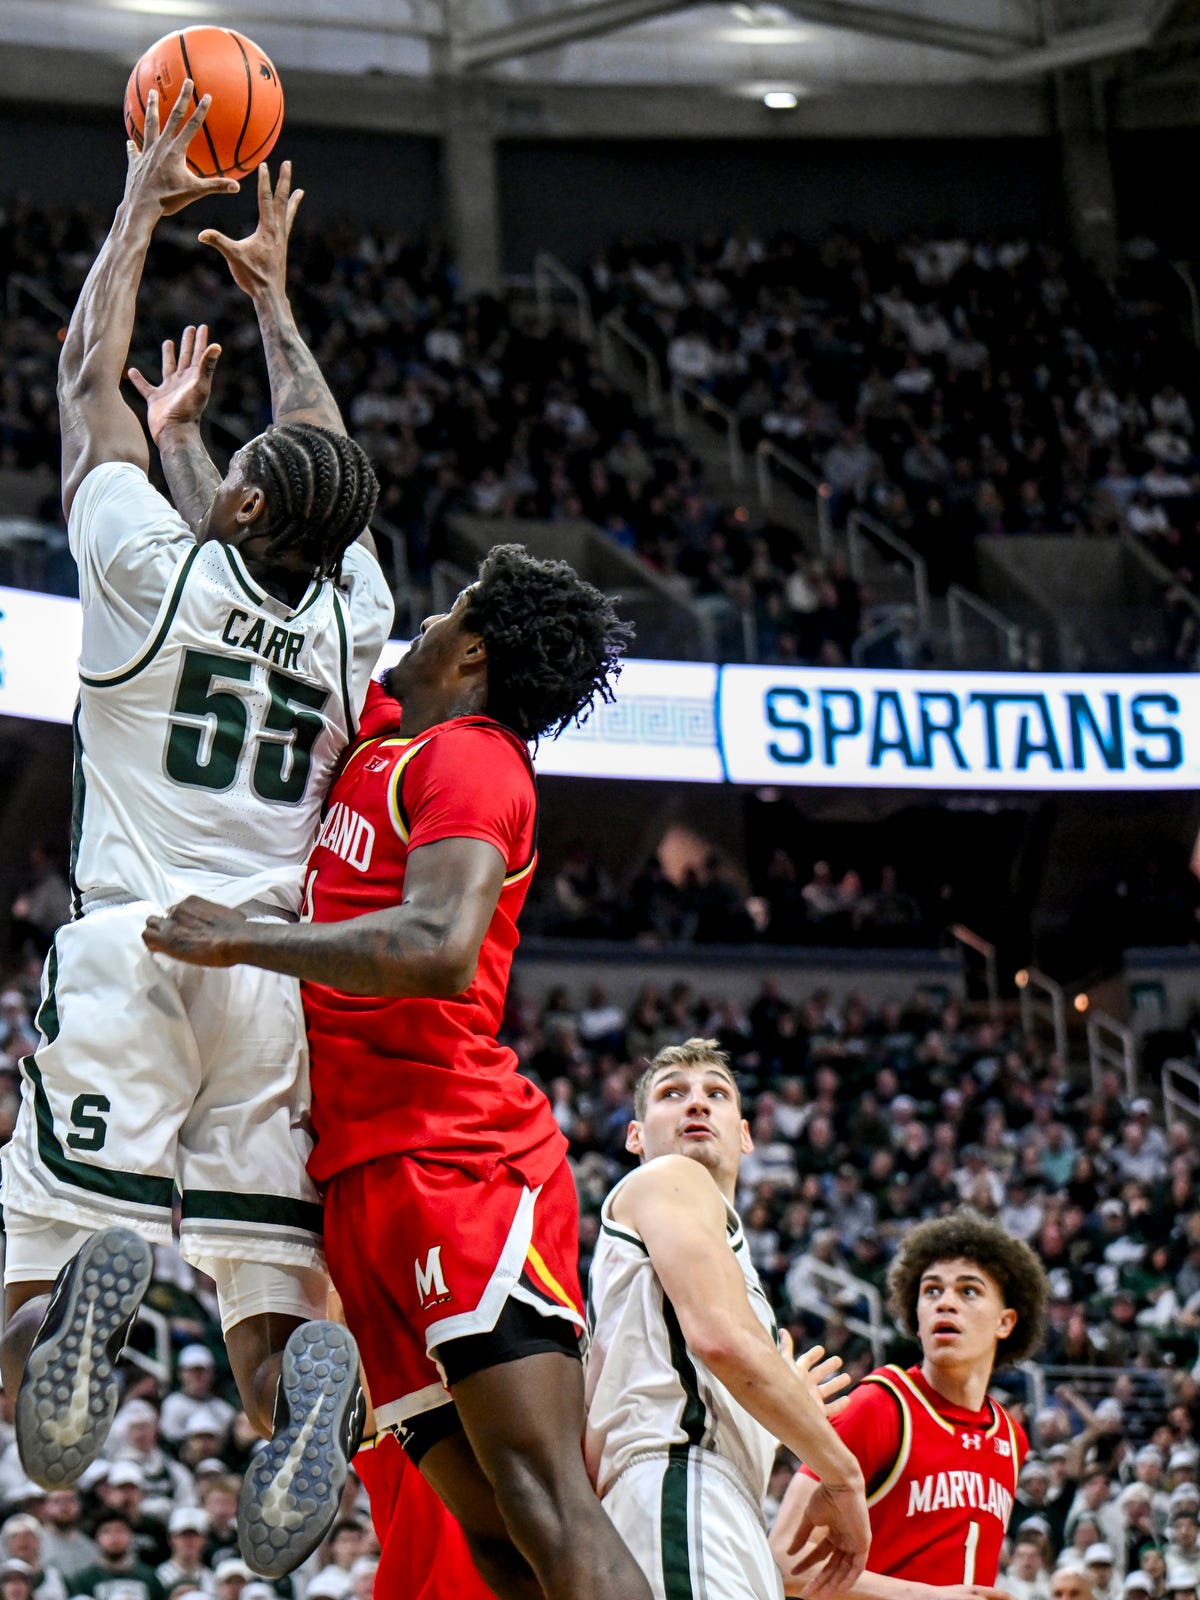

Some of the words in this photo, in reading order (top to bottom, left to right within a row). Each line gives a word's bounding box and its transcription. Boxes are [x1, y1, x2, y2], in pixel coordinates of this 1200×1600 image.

[221, 608, 306, 671] CARR
[162, 645, 332, 807] 55
[765, 687, 1183, 771] SPARTANS
[65, 1093, 111, 1152] S
[414, 1245, 450, 1307] M
[963, 1520, 980, 1585] 1
